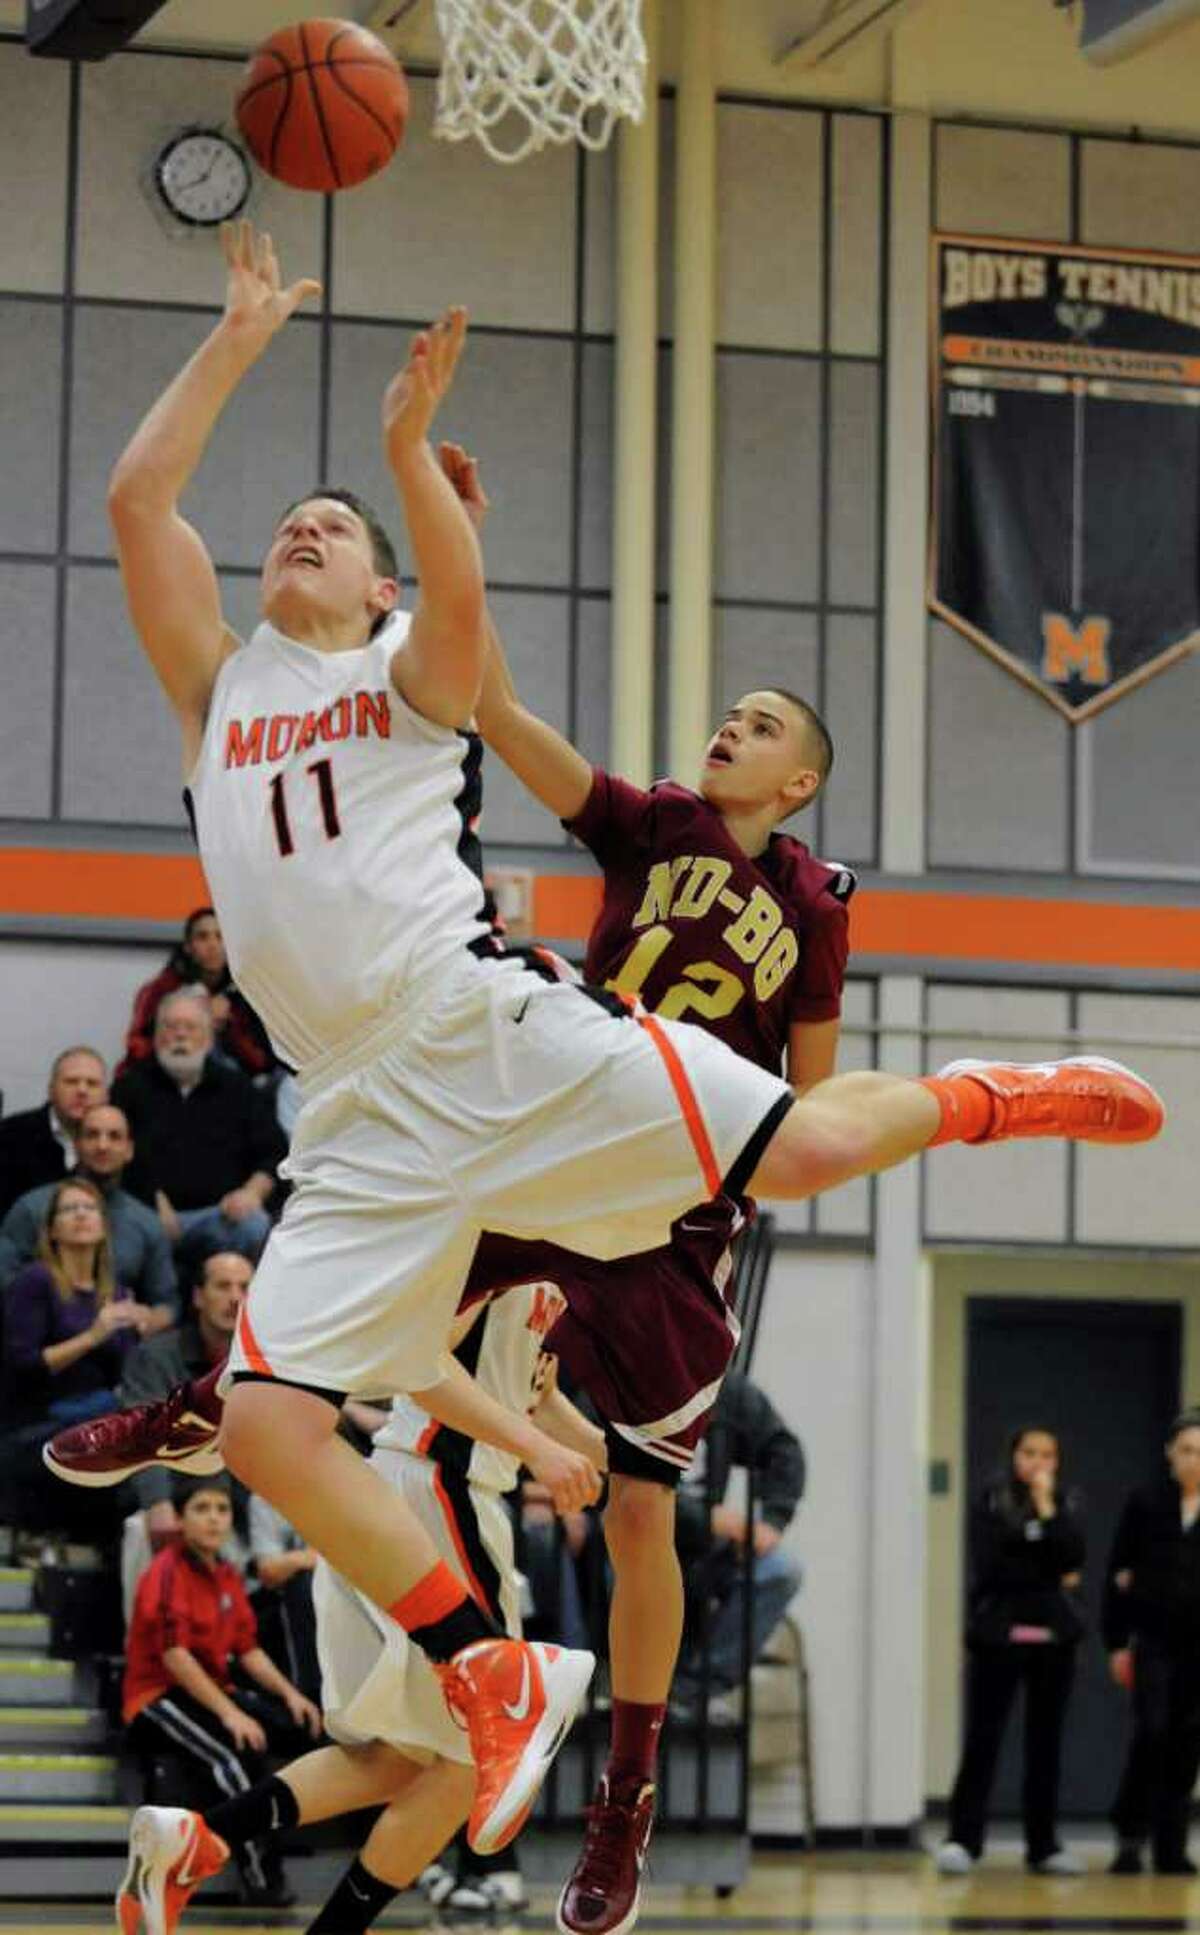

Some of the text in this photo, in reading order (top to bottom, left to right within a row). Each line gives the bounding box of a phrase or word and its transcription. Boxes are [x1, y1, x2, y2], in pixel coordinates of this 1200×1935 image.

[943, 249, 1047, 308] BOYS
[1042, 613, 1111, 685] M
[269, 756, 341, 858] 11
[604, 925, 746, 1021] 12
[631, 855, 799, 1002] ND-BG
